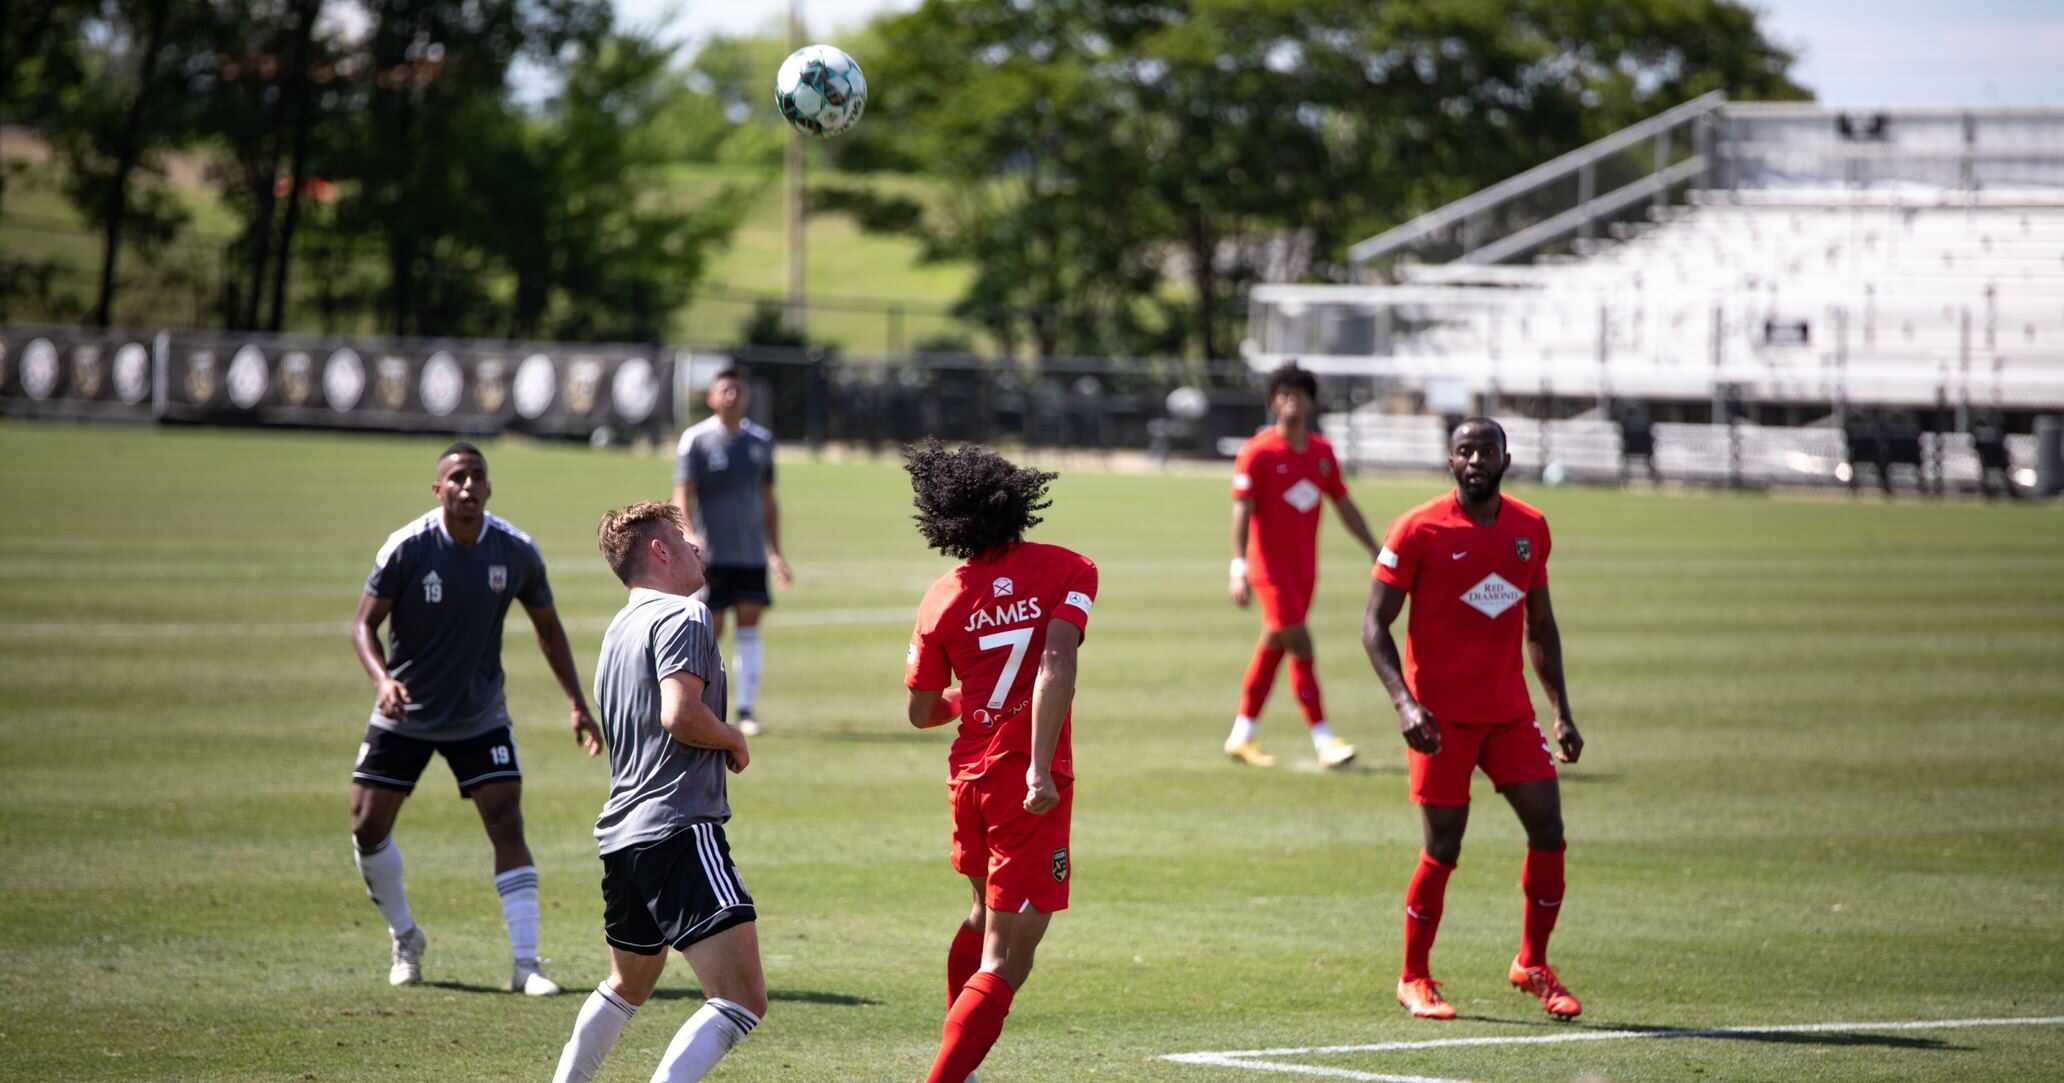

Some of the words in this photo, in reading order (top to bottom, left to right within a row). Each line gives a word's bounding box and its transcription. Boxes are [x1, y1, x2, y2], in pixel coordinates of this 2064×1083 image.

[424, 584, 442, 603] 19
[1469, 591, 1519, 601] DIAMOND
[1484, 583, 1504, 592] RED
[964, 597, 1042, 632] JAMES
[979, 627, 1034, 710] 7
[490, 745, 510, 765] 19
